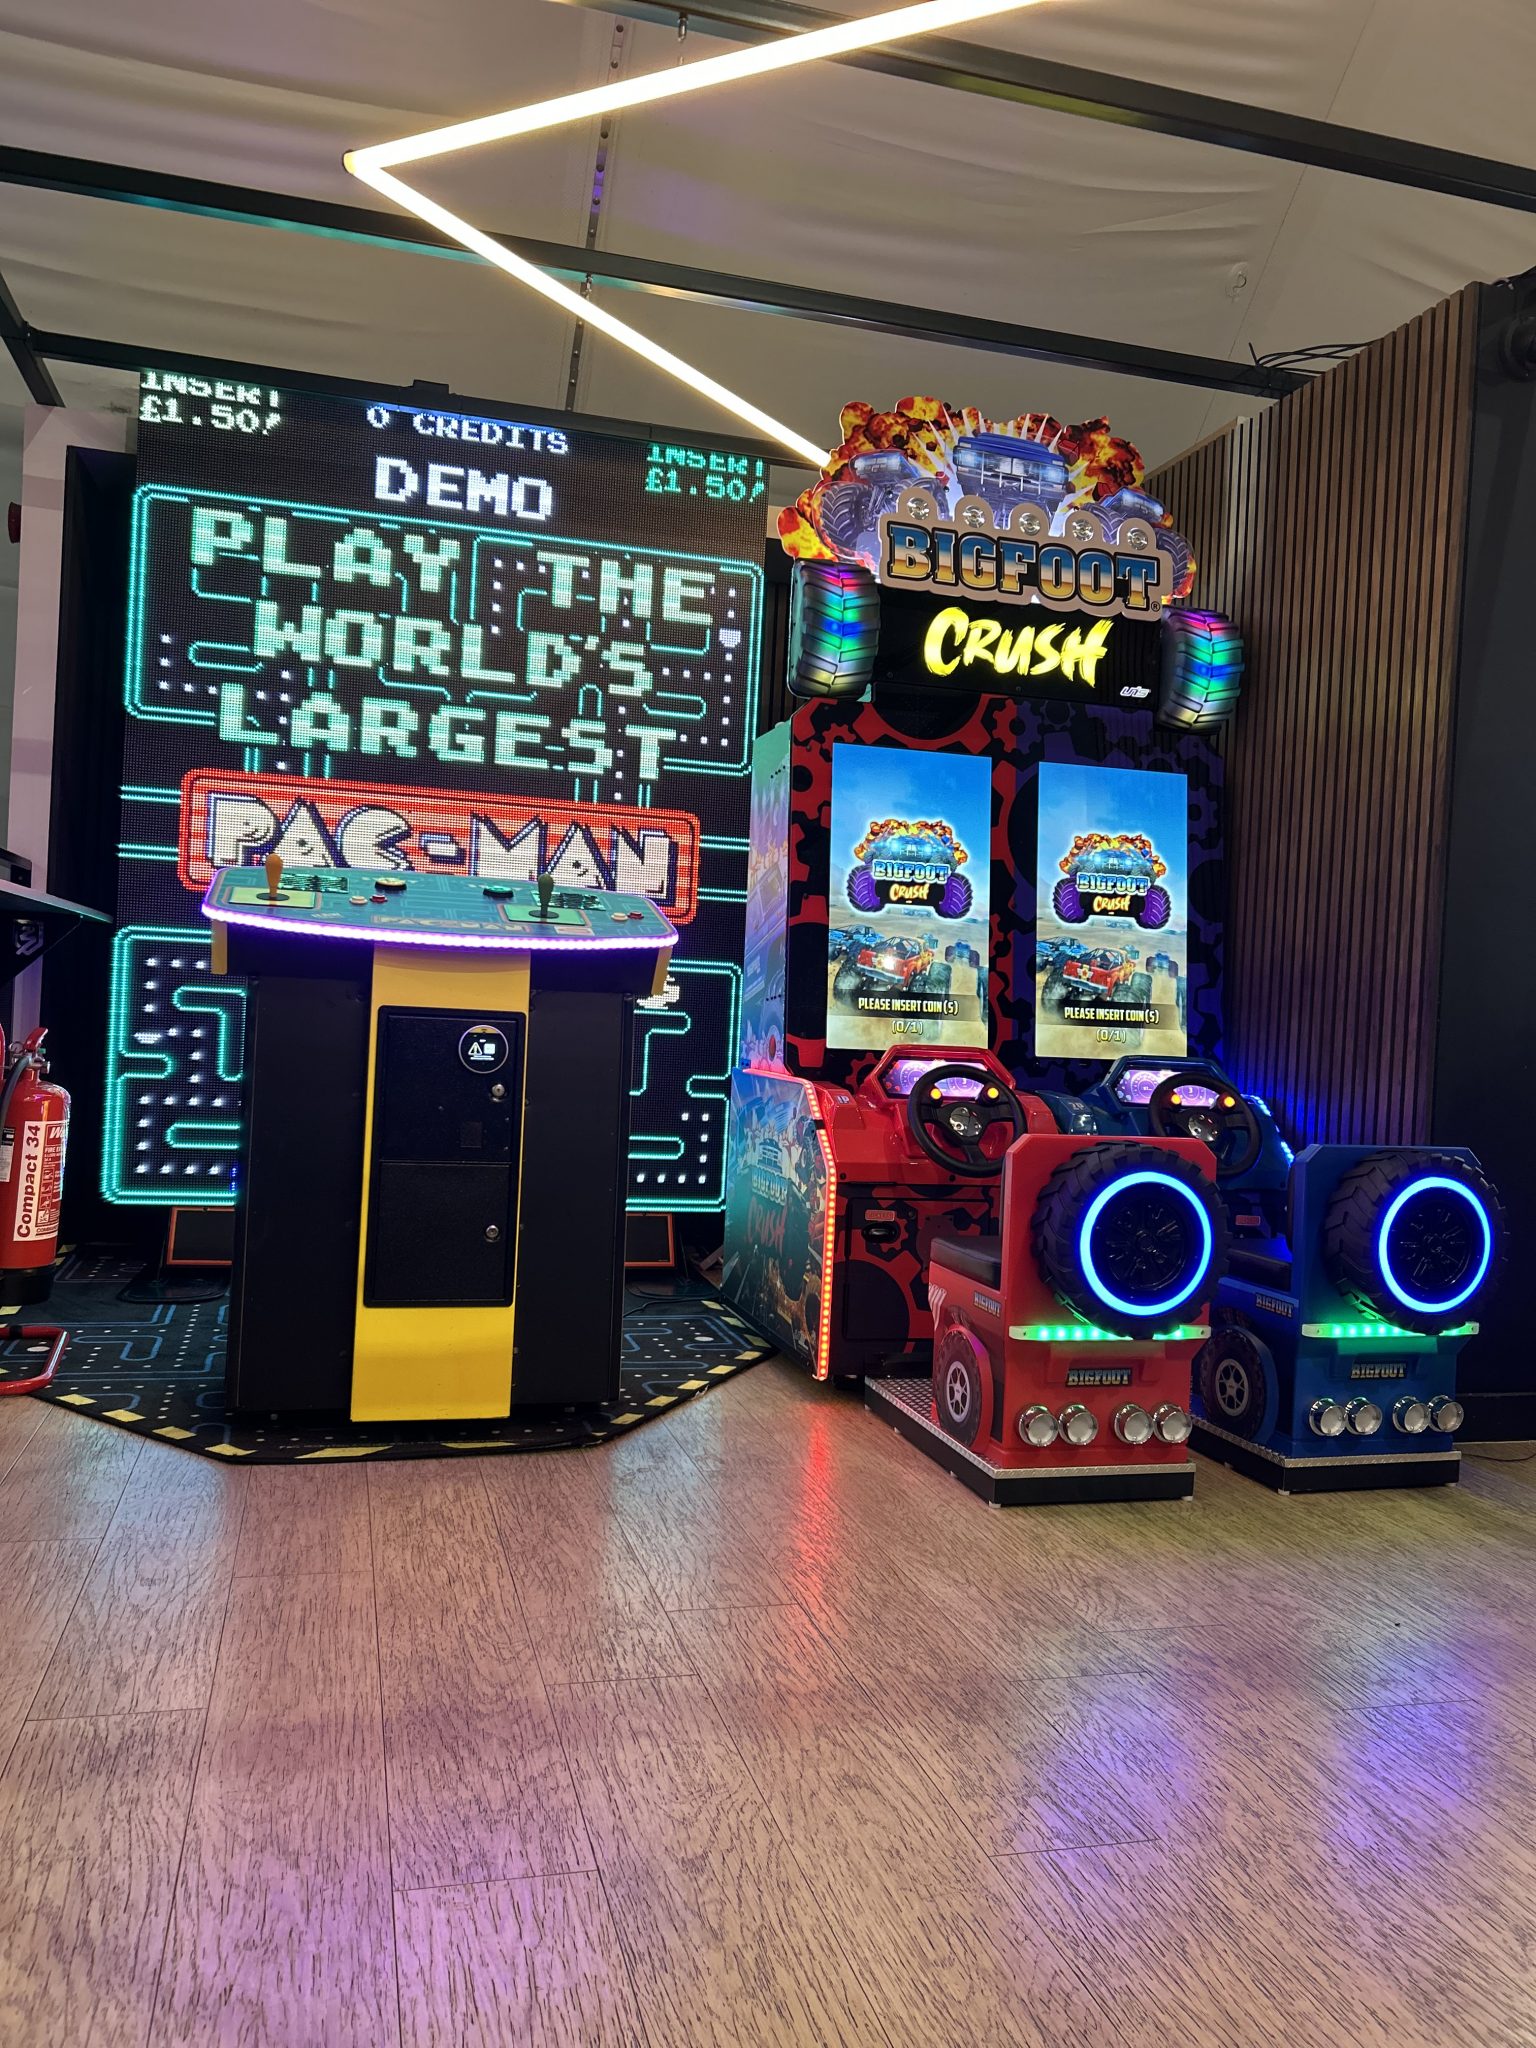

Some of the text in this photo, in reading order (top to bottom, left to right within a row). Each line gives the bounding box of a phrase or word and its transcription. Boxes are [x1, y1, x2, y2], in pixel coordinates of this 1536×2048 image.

[413, 413, 568, 455] CREDITS
[374, 455, 552, 521] DEMO
[191, 506, 715, 626] PLAY THE
[886, 522, 1160, 611] BIGFOOT
[254, 599, 653, 697] WORLD'S
[923, 606, 1115, 688] CRUSH
[218, 682, 677, 780] LARGEST
[206, 791, 680, 904] PAC-MAN
[873, 860, 949, 881] BIGFOOT
[889, 883, 930, 901] CRUSH
[1077, 873, 1149, 894] BIGFOOT
[1092, 895, 1131, 912] CRUSH
[858, 997, 891, 1011] PLEASE
[891, 998, 922, 1013] INSERT
[1064, 1006, 1095, 1020] PLEASE
[1096, 1008, 1125, 1021] INSERT
[892, 1020, 924, 1035] (0/1)
[1096, 1028, 1127, 1043] (0/1)
[16, 1125, 41, 1238] Compact 34
[1255, 1293, 1295, 1318] BIGFOOT
[1066, 1367, 1133, 1387] BIGFOOT
[1350, 1362, 1407, 1379] BIGFOOT
